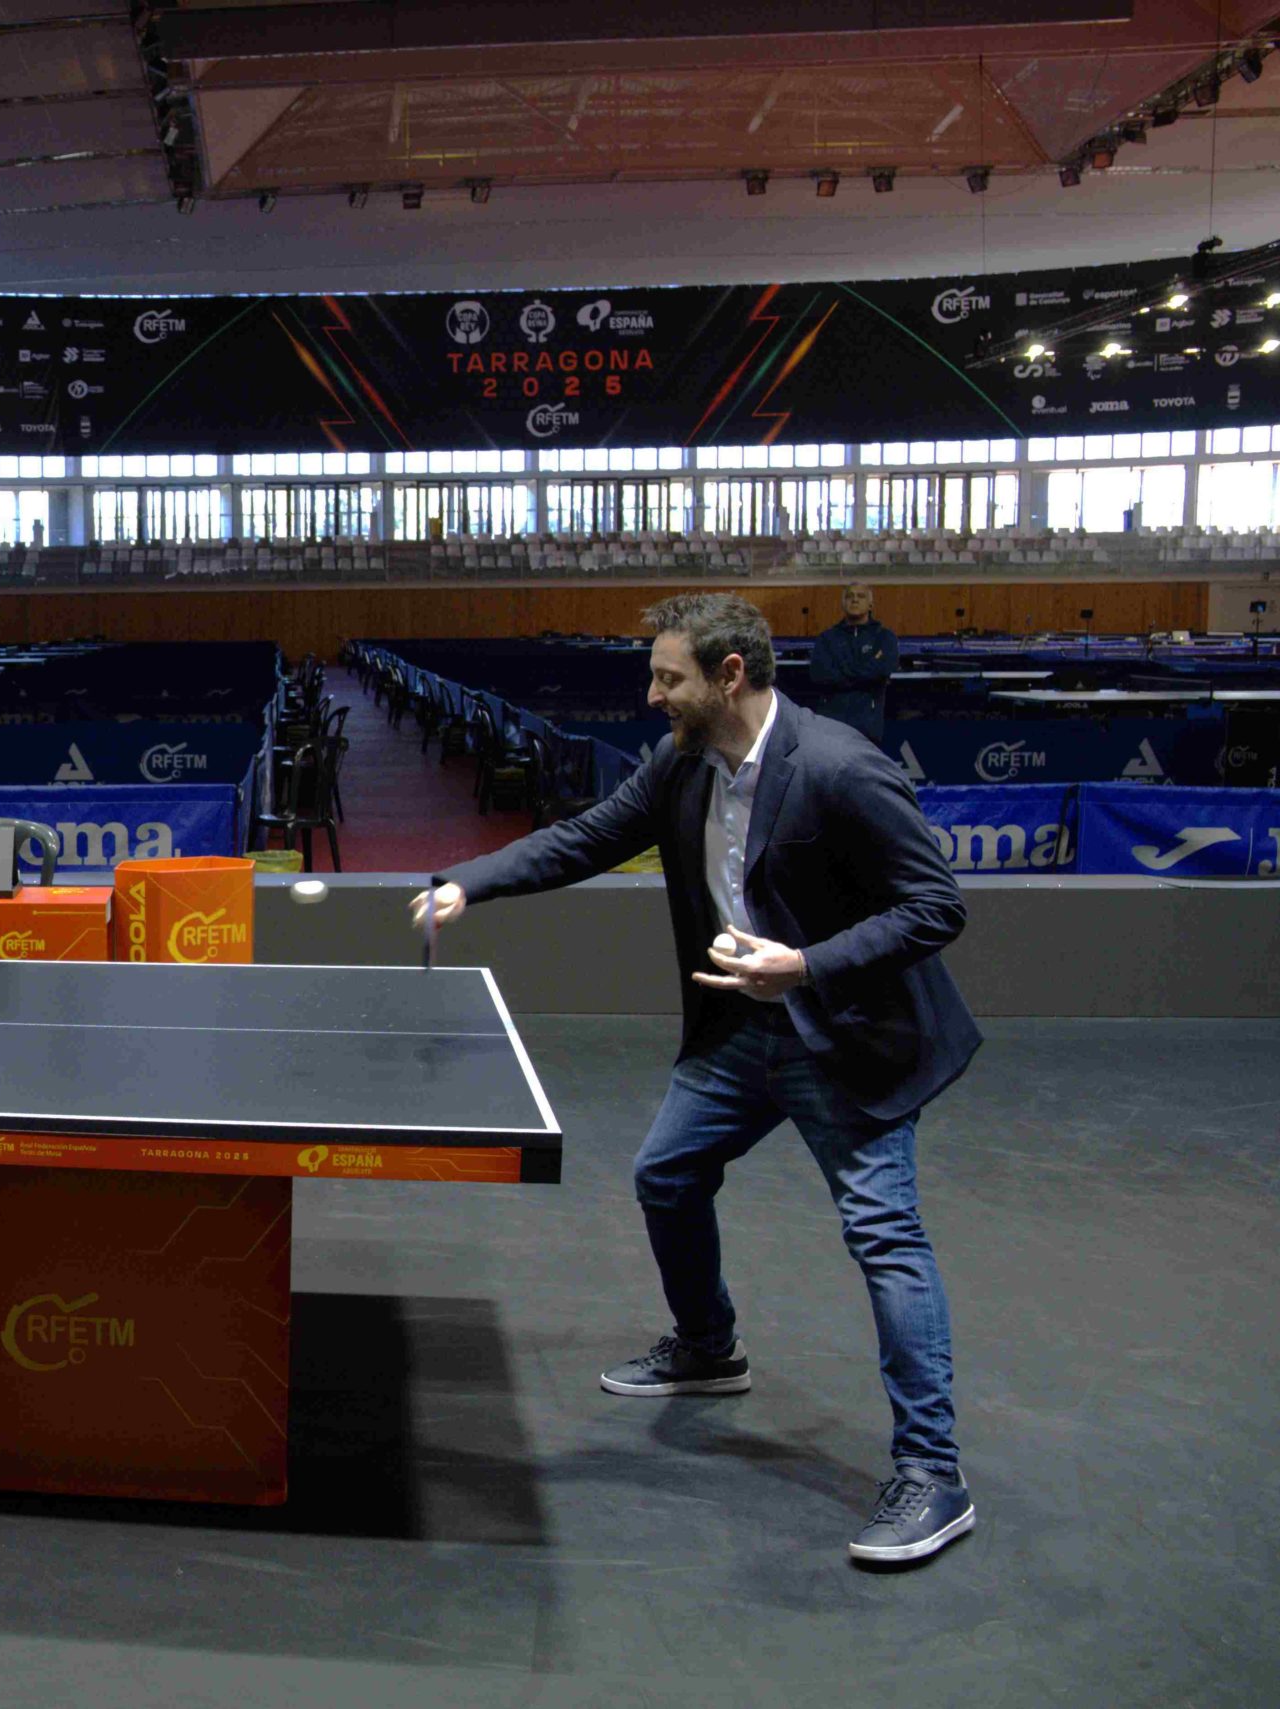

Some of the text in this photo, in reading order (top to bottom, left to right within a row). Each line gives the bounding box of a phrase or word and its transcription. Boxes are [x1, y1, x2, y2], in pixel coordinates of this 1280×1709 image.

[942, 295, 992, 313] RFETM
[142, 318, 187, 332] RFETM
[609, 313, 655, 330] ESPAÑA
[446, 348, 655, 374] TARRAGONA
[1153, 396, 1196, 408] TOYOTA
[535, 412, 580, 426] RFETM
[20, 423, 56, 433] TOYOTA
[152, 754, 207, 769] RFETM
[987, 751, 1047, 768] RFETM
[18, 822, 172, 866] oma
[928, 823, 1076, 871] oma
[129, 880, 146, 963] OOLA
[182, 922, 247, 947] RFETM
[5, 938, 46, 952] RFETM
[141, 1148, 249, 1161] TARRAGONA 2025
[332, 1152, 383, 1168] ESPAÑA
[26, 1314, 136, 1347] RFETM
